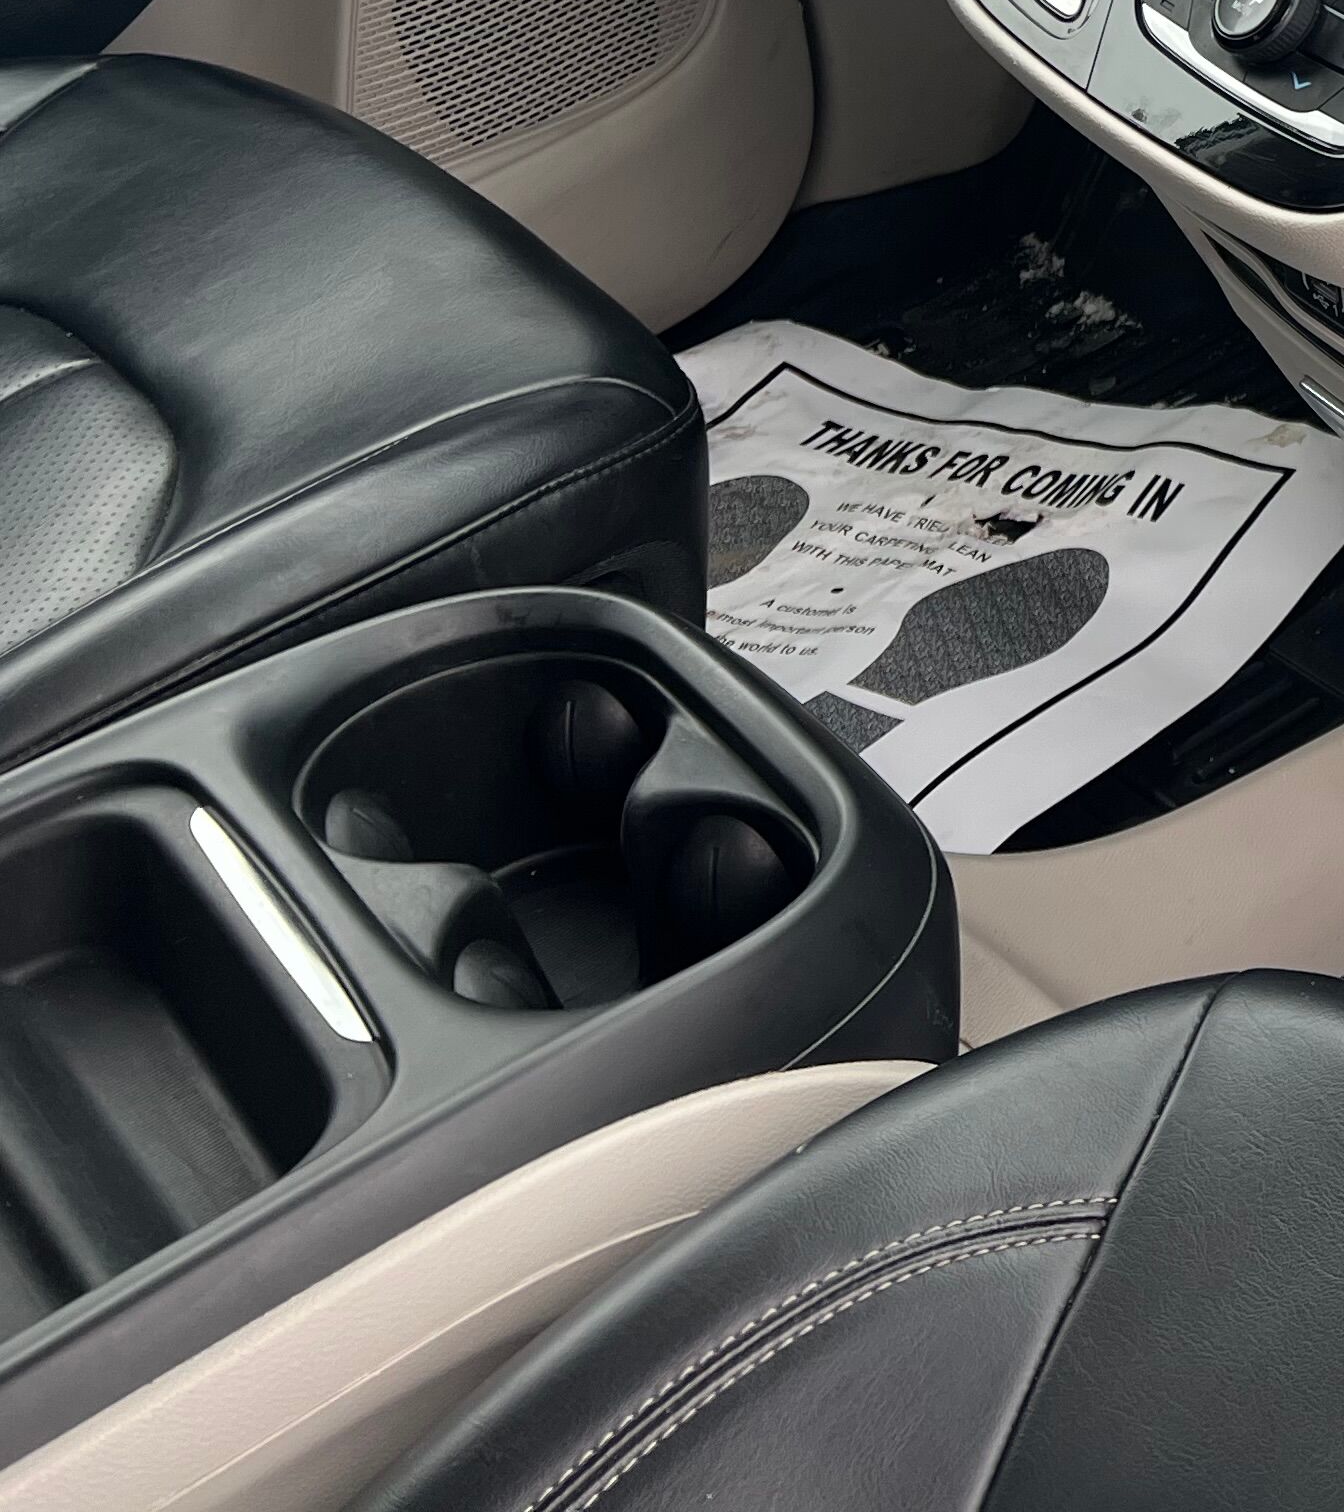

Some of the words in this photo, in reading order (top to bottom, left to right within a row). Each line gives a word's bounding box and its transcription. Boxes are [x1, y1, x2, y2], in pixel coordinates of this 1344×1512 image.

[800, 419, 941, 475] THANKS
[928, 450, 1010, 488] FOR
[1000, 464, 1136, 510] COMING
[1127, 474, 1185, 523] IN
[836, 501, 864, 513] WE
[862, 501, 906, 523] HAVE
[811, 520, 853, 537] YOUR
[948, 541, 993, 563] LEAN
[791, 540, 833, 561] WITH
[833, 553, 868, 568] THIS
[920, 558, 956, 577] MAT
[760, 598, 776, 608] A
[776, 604, 841, 617] customer
[841, 603, 857, 616] is
[716, 614, 757, 627] most
[755, 619, 826, 635] important
[818, 624, 878, 636] person
[738, 640, 781, 654] world
[780, 642, 797, 656] to
